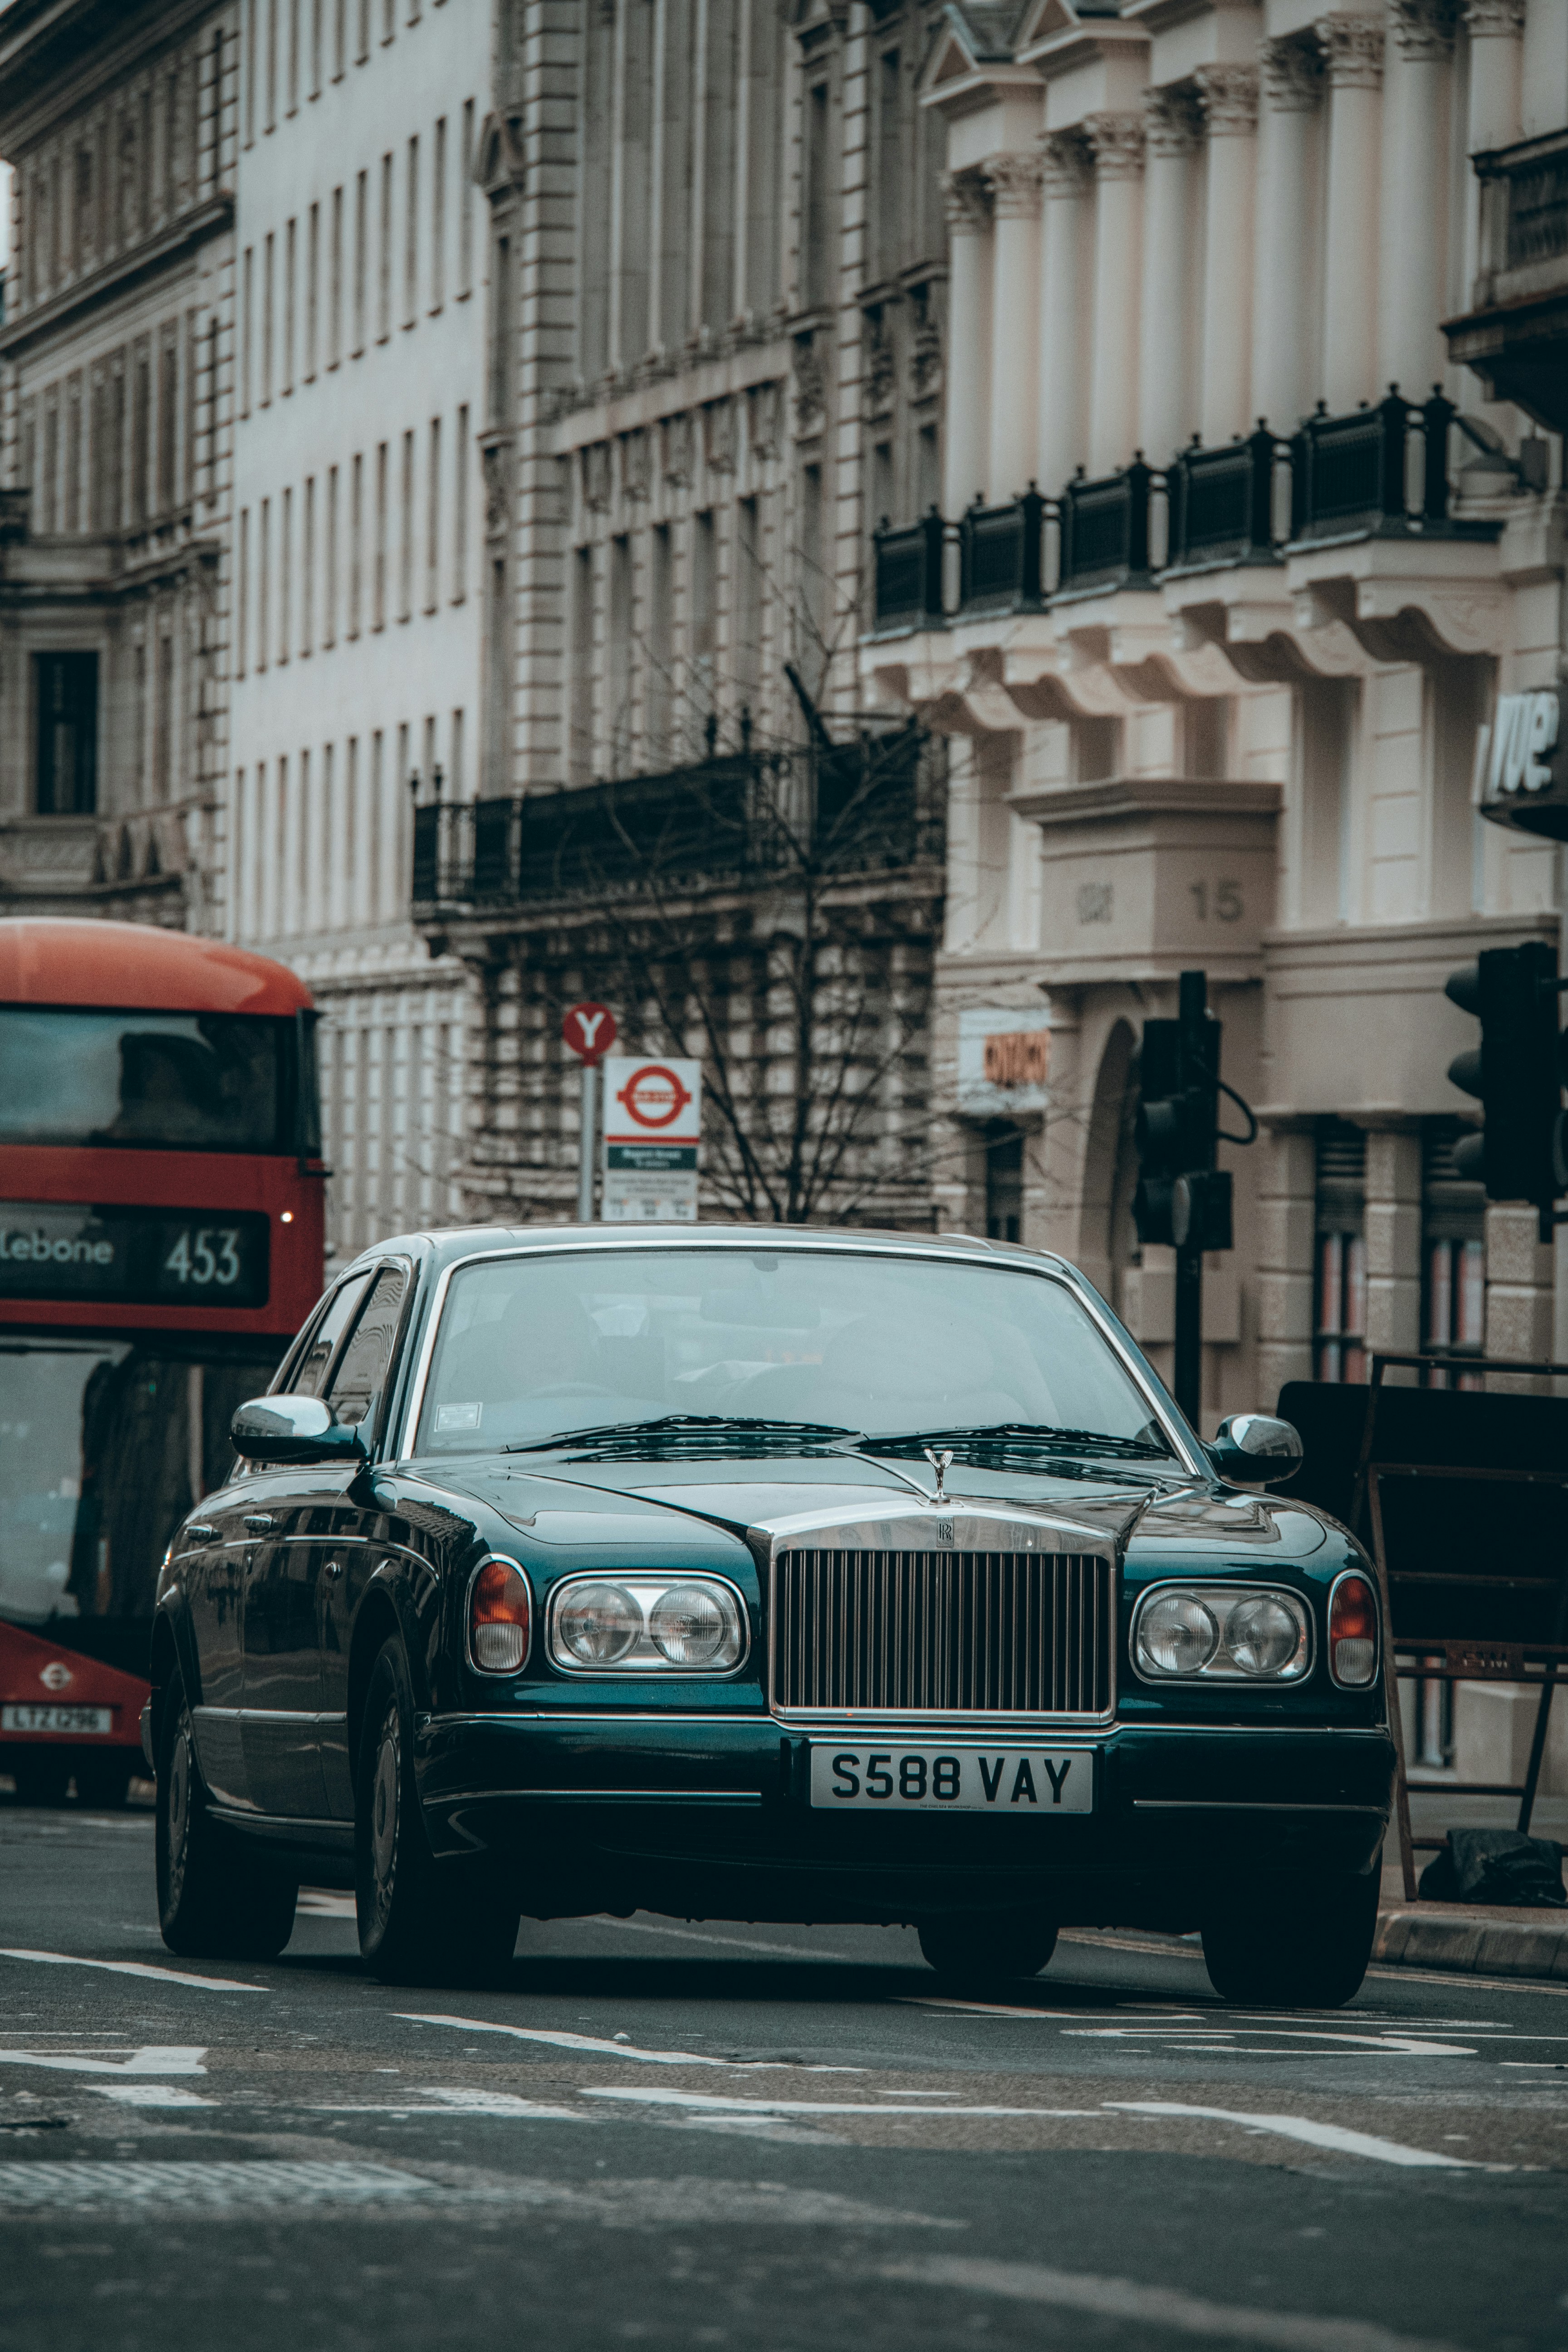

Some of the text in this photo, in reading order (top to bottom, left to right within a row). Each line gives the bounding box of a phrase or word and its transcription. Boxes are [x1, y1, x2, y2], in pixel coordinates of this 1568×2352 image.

[1190, 881, 1245, 923] 15
[574, 1011, 605, 1048] Y
[165, 1228, 240, 1285] 453
[832, 1754, 1071, 1804] S588 VAY
